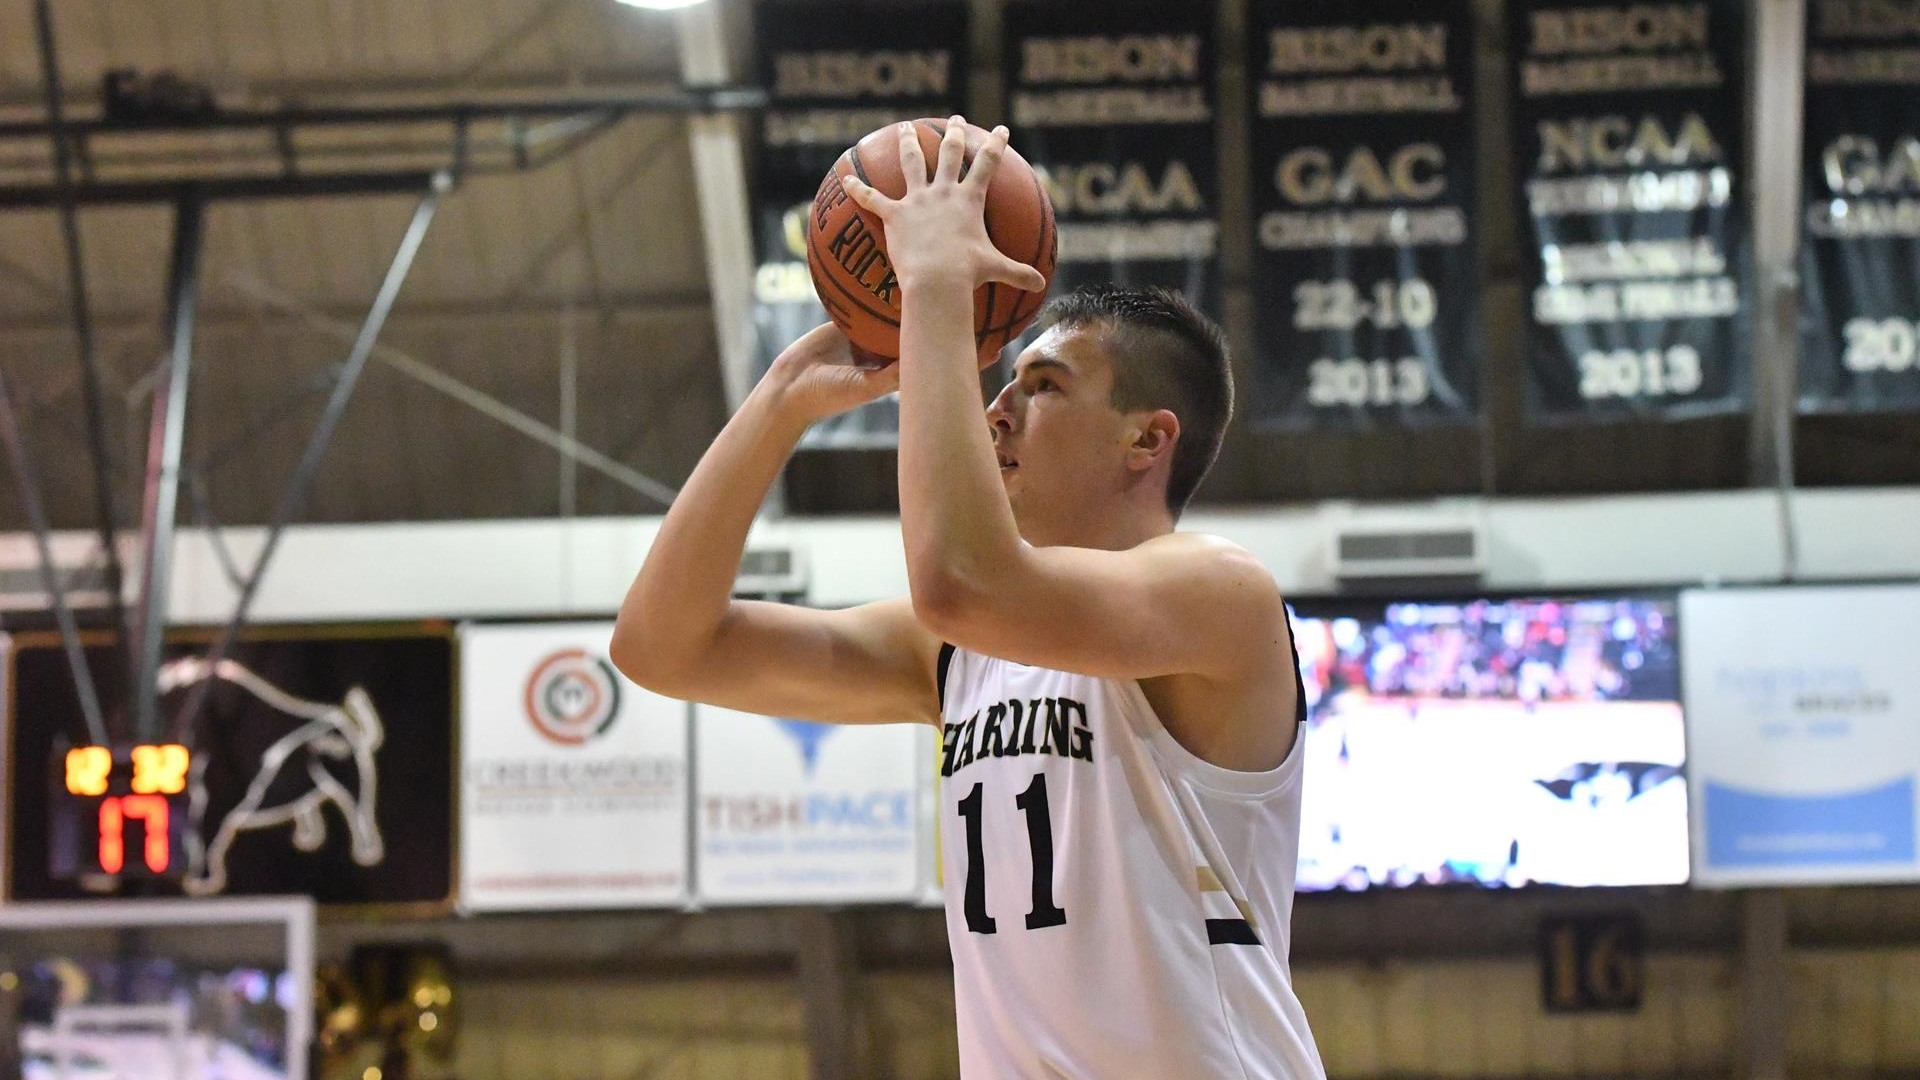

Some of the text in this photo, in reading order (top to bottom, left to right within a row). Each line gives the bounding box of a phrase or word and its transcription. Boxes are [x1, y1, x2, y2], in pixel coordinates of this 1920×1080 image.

[1270, 24, 1446, 73] BISON
[1537, 114, 1724, 170] NCAA
[1276, 143, 1448, 204] GAC
[1294, 278, 1437, 330] 22-10
[1578, 345, 1702, 398] 2013
[1842, 315, 1920, 372] 20
[1308, 358, 1428, 406] 2013
[99, 794, 170, 874] 17
[957, 772, 1067, 934] 11
